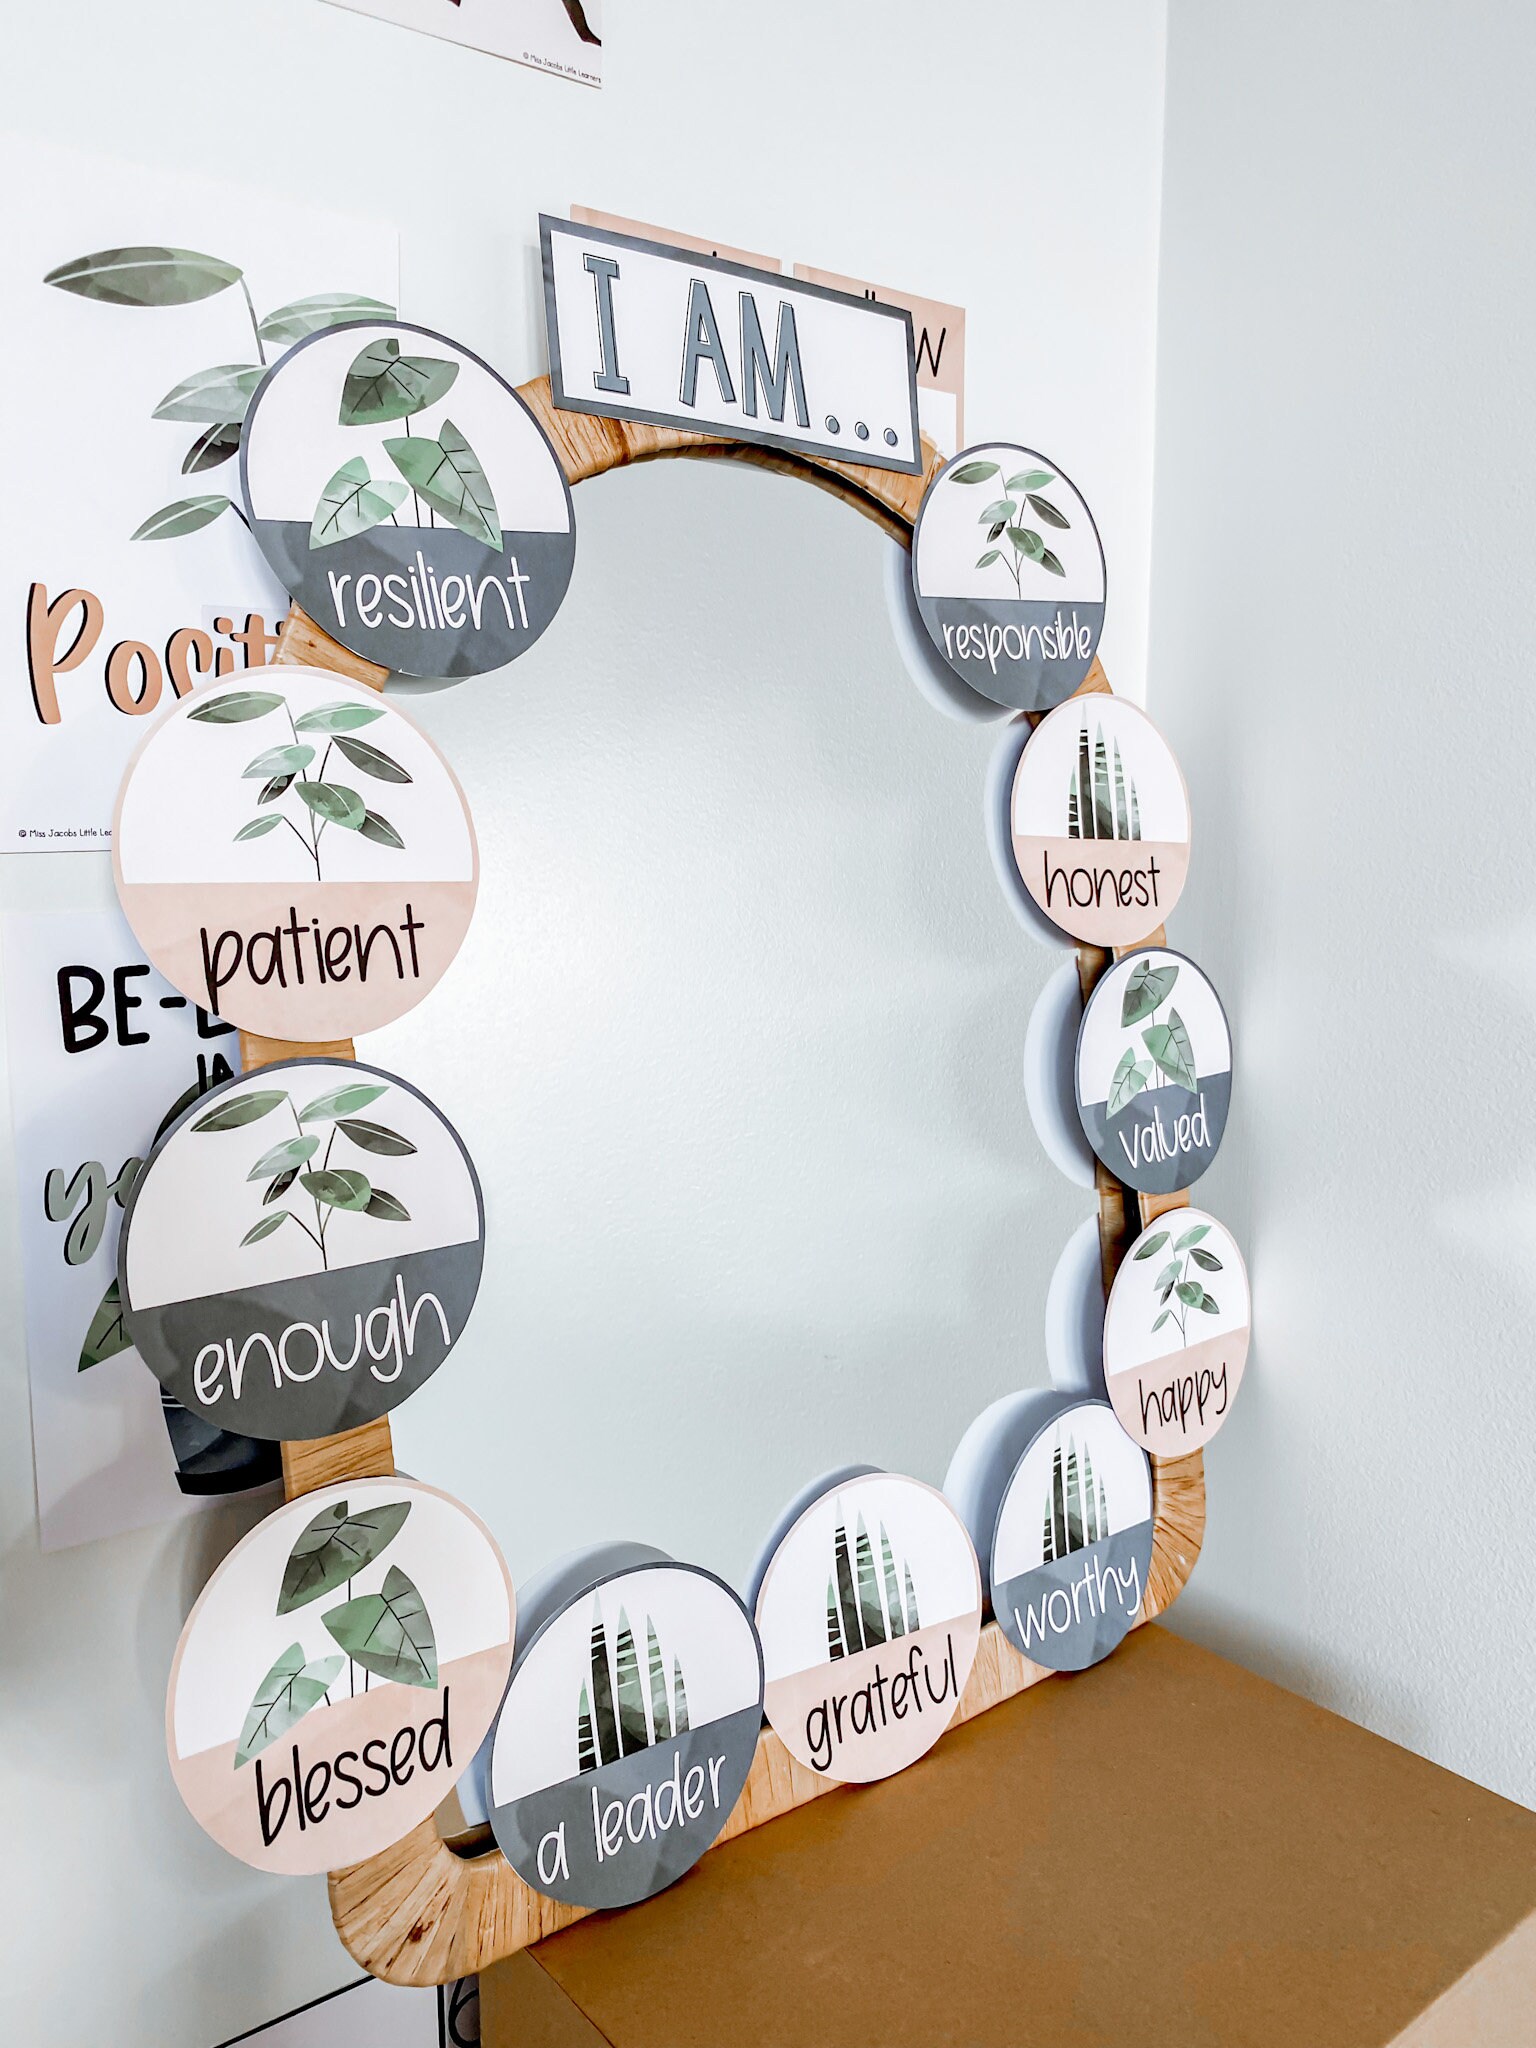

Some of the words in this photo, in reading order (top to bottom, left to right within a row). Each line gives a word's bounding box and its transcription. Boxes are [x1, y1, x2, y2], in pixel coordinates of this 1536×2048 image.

[530, 53, 542, 65] Miss
[543, 57, 563, 72] Jacobs
[583, 253, 630, 395] I
[327, 550, 531, 630] resilient
[26, 582, 286, 724] Posit
[942, 611, 1092, 675] responsible
[29, 829, 46, 838] Miss
[48, 828, 77, 838] Jacobs
[79, 827, 98, 837] Little
[1044, 850, 1161, 908] honest
[200, 903, 425, 1016] patient
[1118, 1092, 1211, 1169] valued
[193, 1273, 451, 1406] enough
[1138, 1362, 1228, 1435] happy
[1013, 1554, 1141, 1649] worthy
[805, 1633, 958, 1772] grateful
[255, 1685, 453, 1847] blessed
[536, 1821, 570, 1885] a
[590, 1750, 727, 1863] leader
